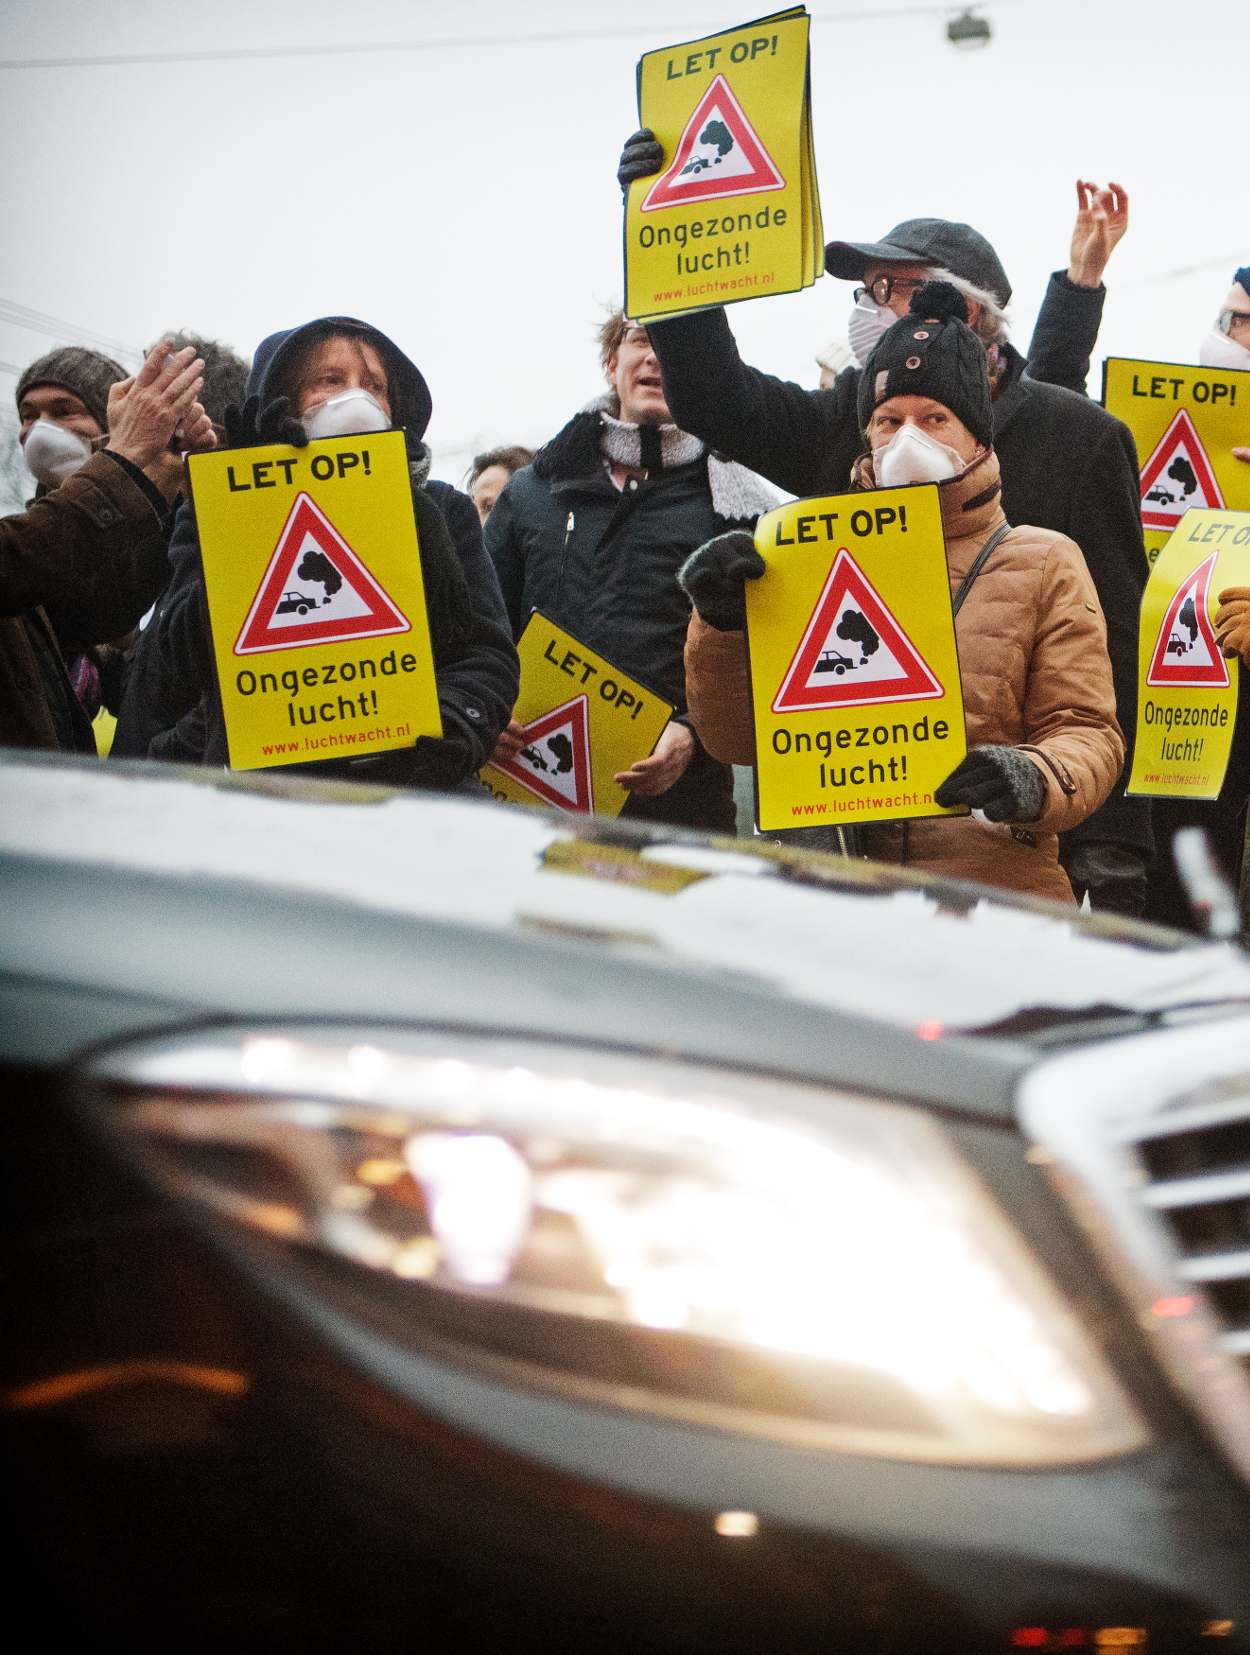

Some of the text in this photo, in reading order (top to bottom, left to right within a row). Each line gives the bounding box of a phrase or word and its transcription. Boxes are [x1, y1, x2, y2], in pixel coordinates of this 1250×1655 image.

[667, 35, 779, 81] LET OP!
[639, 206, 788, 248] Ongezonde
[677, 241, 750, 275] lucht!
[653, 271, 775, 302] www.luchtwacht.nl
[1132, 375, 1236, 406] LET OP!
[227, 450, 372, 492] LET OP!
[776, 506, 907, 546] LET OP!
[1188, 523, 1228, 543] LET
[236, 650, 418, 697] Ongezonde
[543, 640, 644, 720] LET OP!
[288, 690, 380, 727] lucht!
[1144, 700, 1229, 732] Ongezonde
[262, 723, 411, 756] www.luchtwacht.nl
[772, 716, 949, 758] Ongezonde
[1161, 736, 1204, 762] lucht!
[819, 756, 907, 788] lucht!
[791, 791, 936, 816] www.luchtwacht.n
